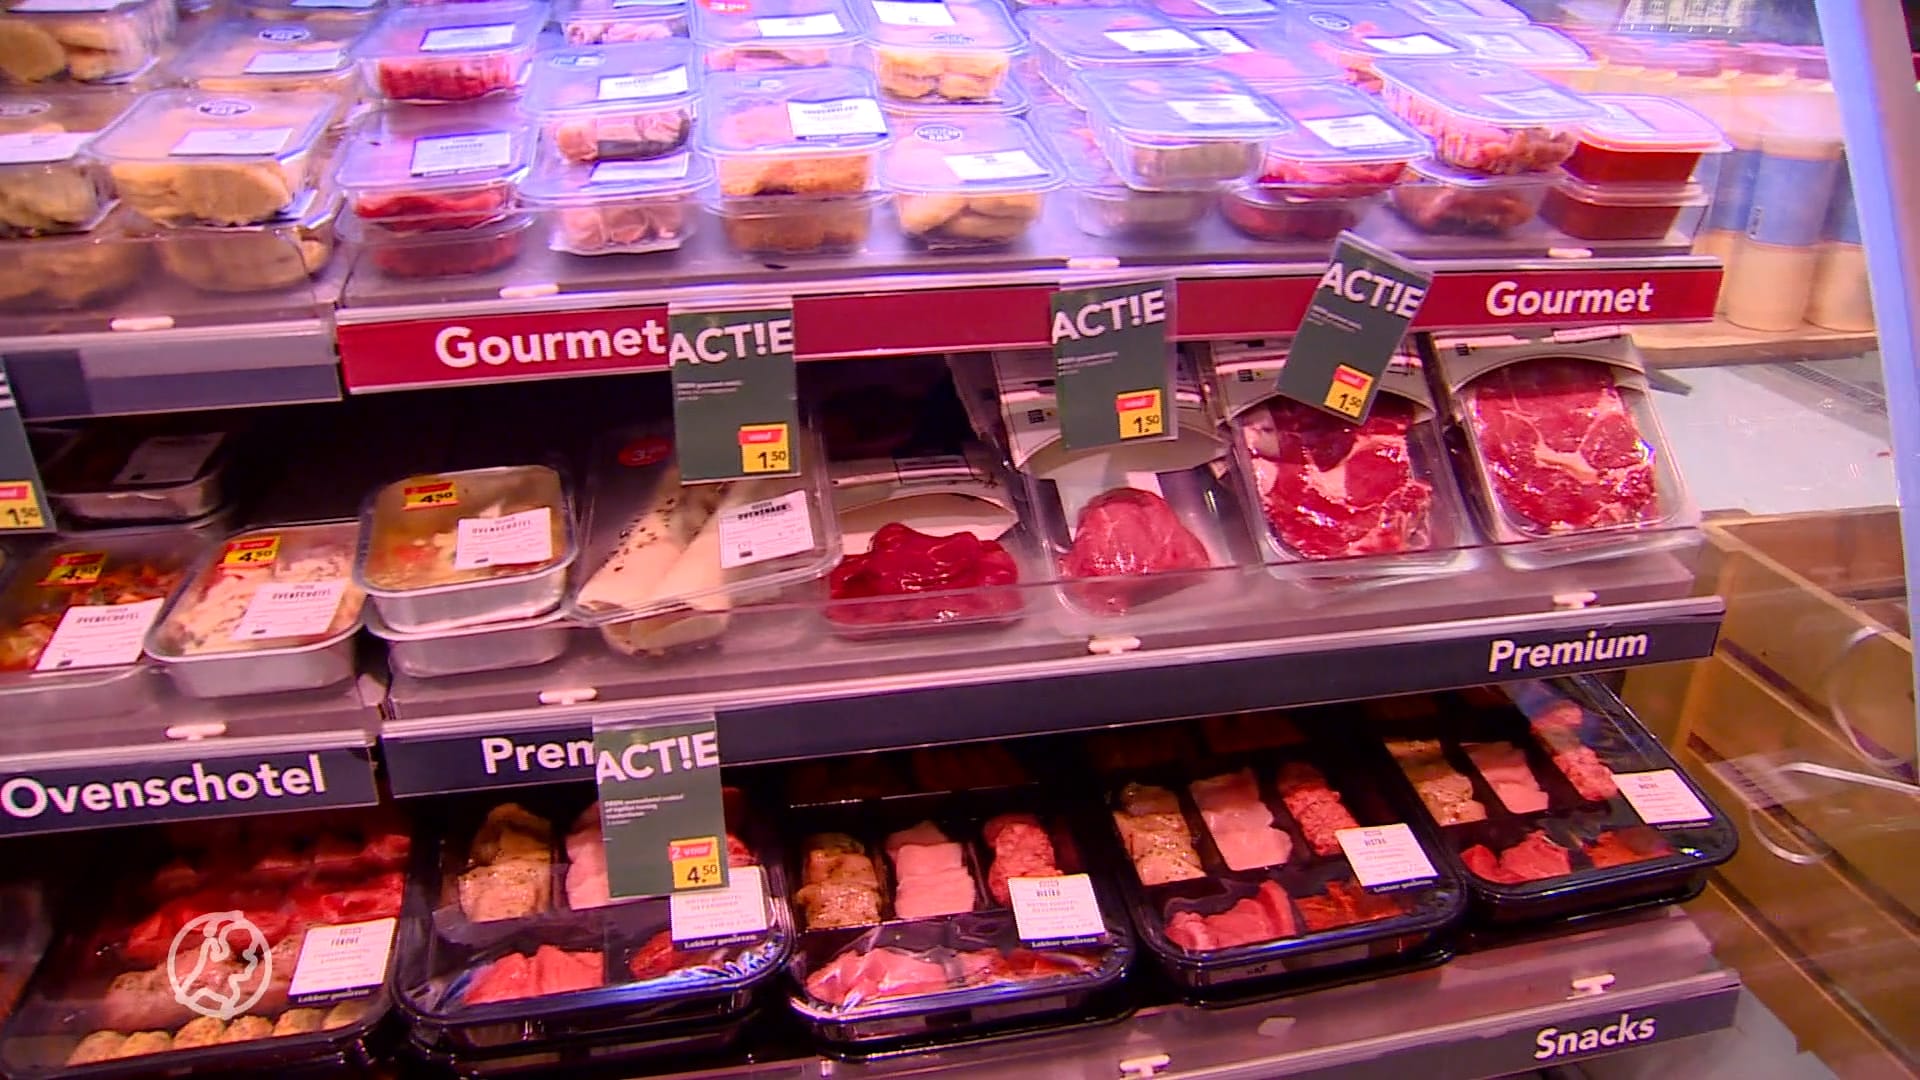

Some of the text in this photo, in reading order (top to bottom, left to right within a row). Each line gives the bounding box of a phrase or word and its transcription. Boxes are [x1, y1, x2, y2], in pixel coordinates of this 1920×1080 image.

[1317, 263, 1426, 319] ACT!E
[1486, 281, 1654, 317] Gourmet
[1052, 290, 1167, 344] ACT!E
[435, 319, 667, 368] Gourmet
[668, 319, 794, 367] ACT!E
[757, 450, 787, 470] 1.50
[1488, 630, 1648, 673] Premium
[481, 737, 595, 775] Prem
[596, 731, 721, 785] ACT!E
[0, 753, 327, 818] Ovenschotel
[1534, 1013, 1657, 1060] Snacks
